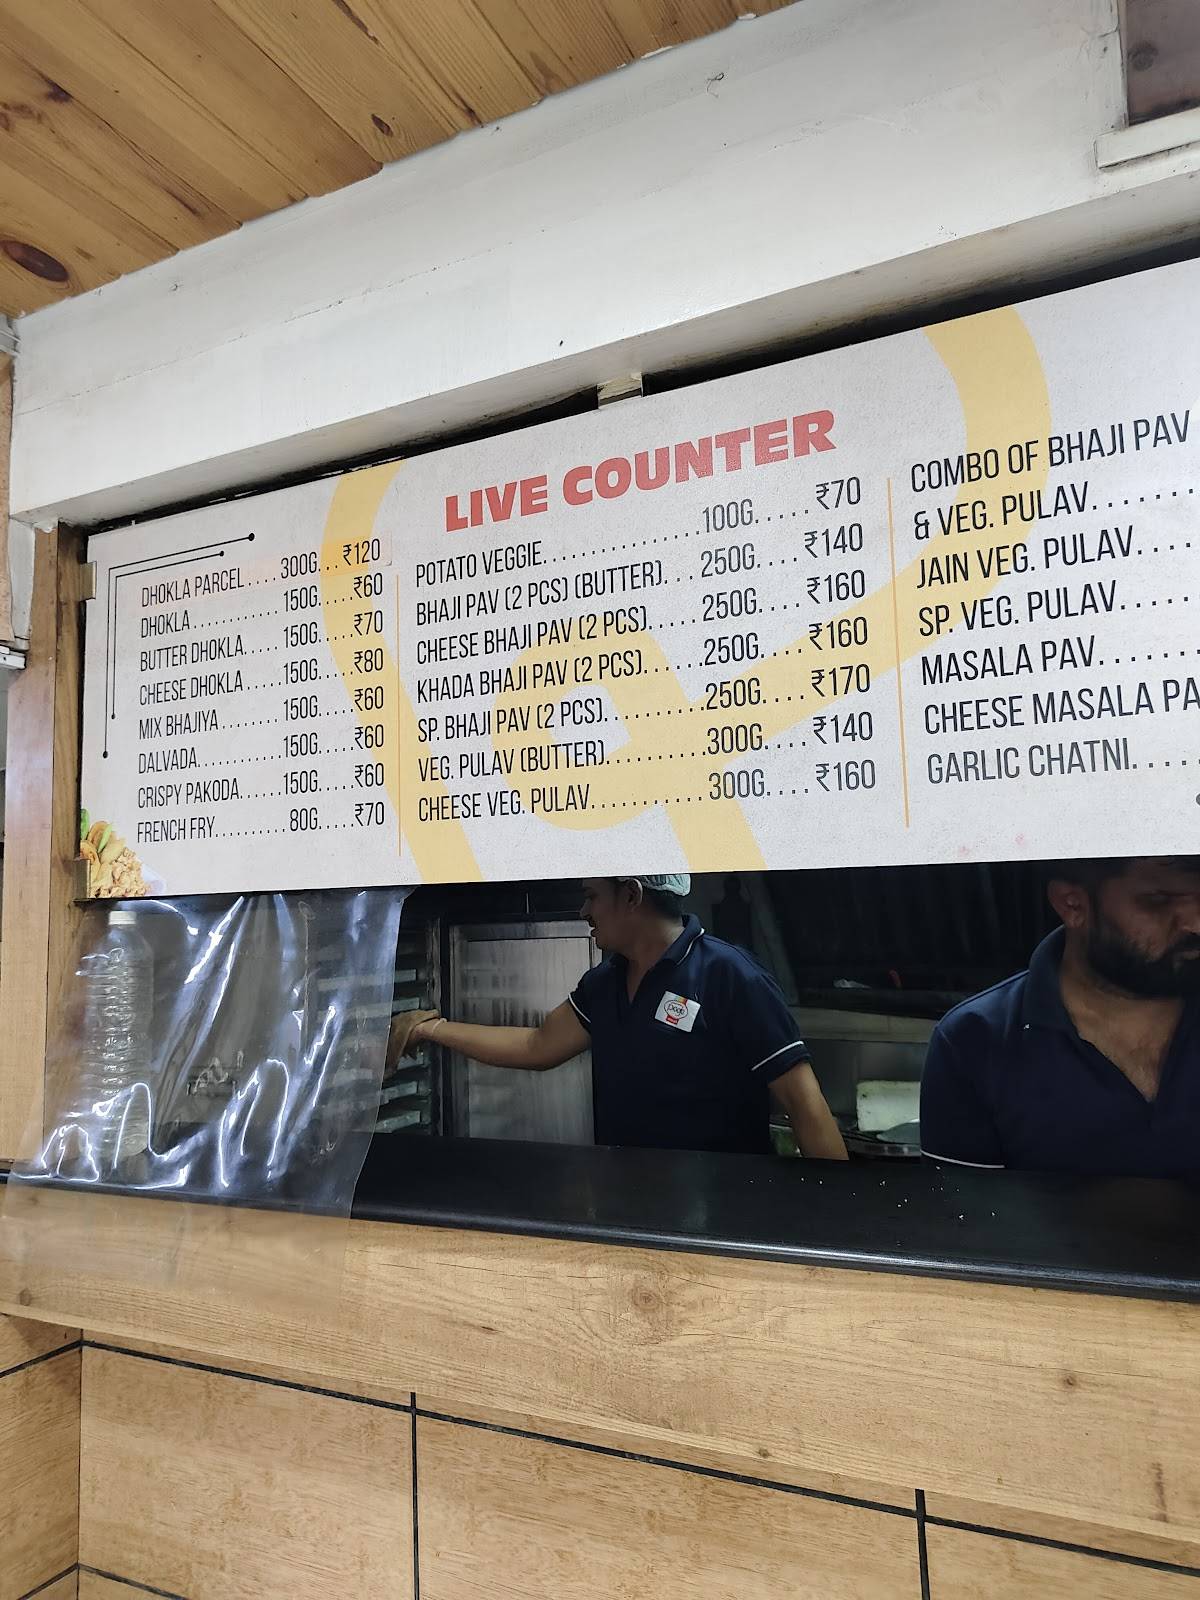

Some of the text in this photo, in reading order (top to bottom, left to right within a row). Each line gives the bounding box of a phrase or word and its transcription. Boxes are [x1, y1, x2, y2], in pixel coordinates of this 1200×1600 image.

[446, 409, 837, 532] LIVE COUNTER
[911, 410, 1190, 493] COMBO OF BHAJI PAV
[416, 476, 861, 588] POTATO VEGGIE 100G ₹70
[914, 481, 1088, 540] & VEG. PULAV
[142, 538, 380, 607] DHOKLA PARCEL 300G ₹120
[417, 595, 461, 626] BHAJI
[466, 588, 499, 618] PAV
[701, 543, 755, 578] 250G
[804, 523, 863, 558] ₹140
[916, 525, 1133, 589] JAIN VEG. PULAV
[141, 572, 383, 638] DHOKLA 150G ₹60
[417, 632, 479, 665] CHEESE
[484, 623, 532, 655] BHAJI
[537, 617, 572, 647] PAV
[702, 587, 757, 622] 250G
[806, 569, 865, 604] ₹160
[919, 579, 1116, 637] SP. VEG. PULAV
[140, 610, 383, 672] BUTTER DHOKLA 150G ₹70
[417, 673, 475, 704] KHADA
[480, 665, 527, 696] BHAJI
[533, 659, 568, 689] PAV
[704, 632, 759, 666] 250G
[808, 616, 868, 650] ₹160
[921, 635, 1095, 686] MASALA PAV
[140, 648, 383, 706] CHEESE DHOKLA 150G ₹80
[418, 717, 440, 742] SP.
[445, 710, 491, 740] BHAJI
[496, 705, 531, 734] PAV
[705, 677, 761, 710] 250G
[811, 664, 870, 697] ₹170
[924, 695, 1025, 735] CHEESE
[1032, 682, 1155, 725] MASALA
[139, 686, 384, 740] MIX BHAJIYA 150G ₹60
[138, 724, 384, 774] DALVADA 150G ₹60
[418, 755, 454, 782] VEG.
[459, 748, 514, 779] PULAV
[707, 723, 763, 755] 300G
[813, 711, 873, 744] ₹140
[927, 737, 1129, 784] GARLIC CHATNI
[138, 762, 384, 808] CRISPY PAKODA 150G ₹60
[419, 759, 875, 822] CHEESE VEG. PULAV 300G ₹160
[137, 801, 384, 843] FRENCH FRY 80G ₹70
